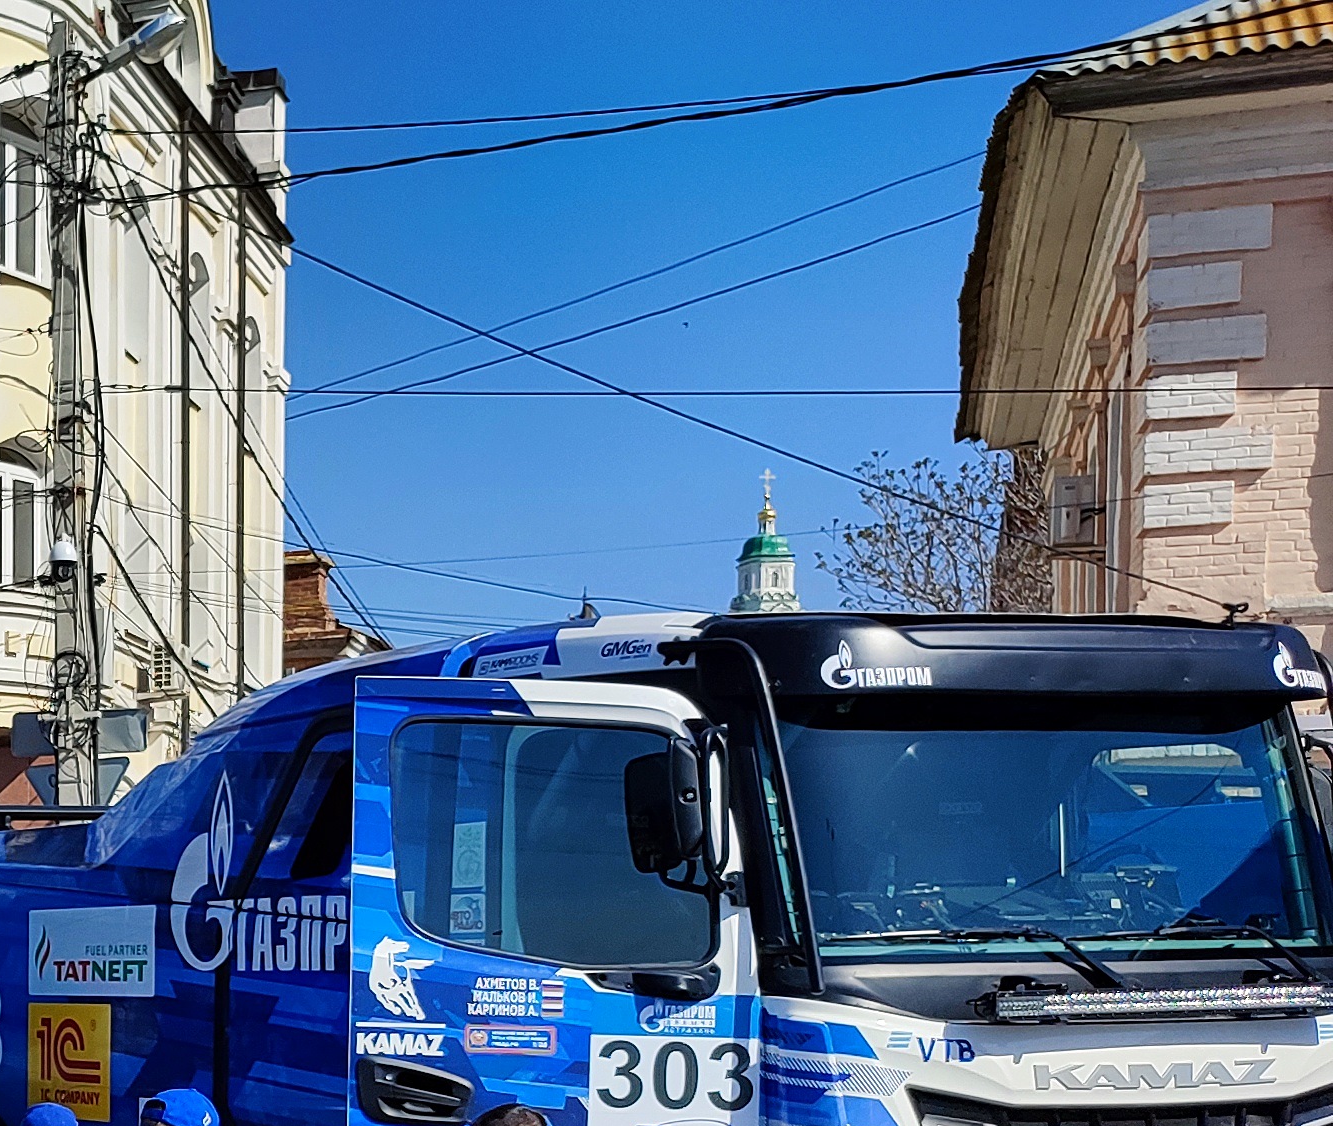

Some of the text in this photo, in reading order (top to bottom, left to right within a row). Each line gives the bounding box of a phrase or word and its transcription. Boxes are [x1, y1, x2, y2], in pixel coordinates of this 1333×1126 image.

[856, 666, 933, 688] ГАЗПРОМ
[85, 944, 148, 956] FUEL PARTNER
[53, 960, 148, 982] TATNEFT
[475, 977, 526, 990] АХМЕТОВ
[472, 990, 525, 1003] МАЛЬКОВ
[467, 1003, 525, 1016] КАРГИНОВ
[664, 1005, 717, 1019] ГАЗПРОМ
[356, 1032, 445, 1057] KAMAZ
[917, 1037, 976, 1063] VTB
[596, 1040, 754, 1111] 303
[1033, 1058, 1278, 1091] KAMAZ
[55, 1088, 100, 1106] COMPANY
